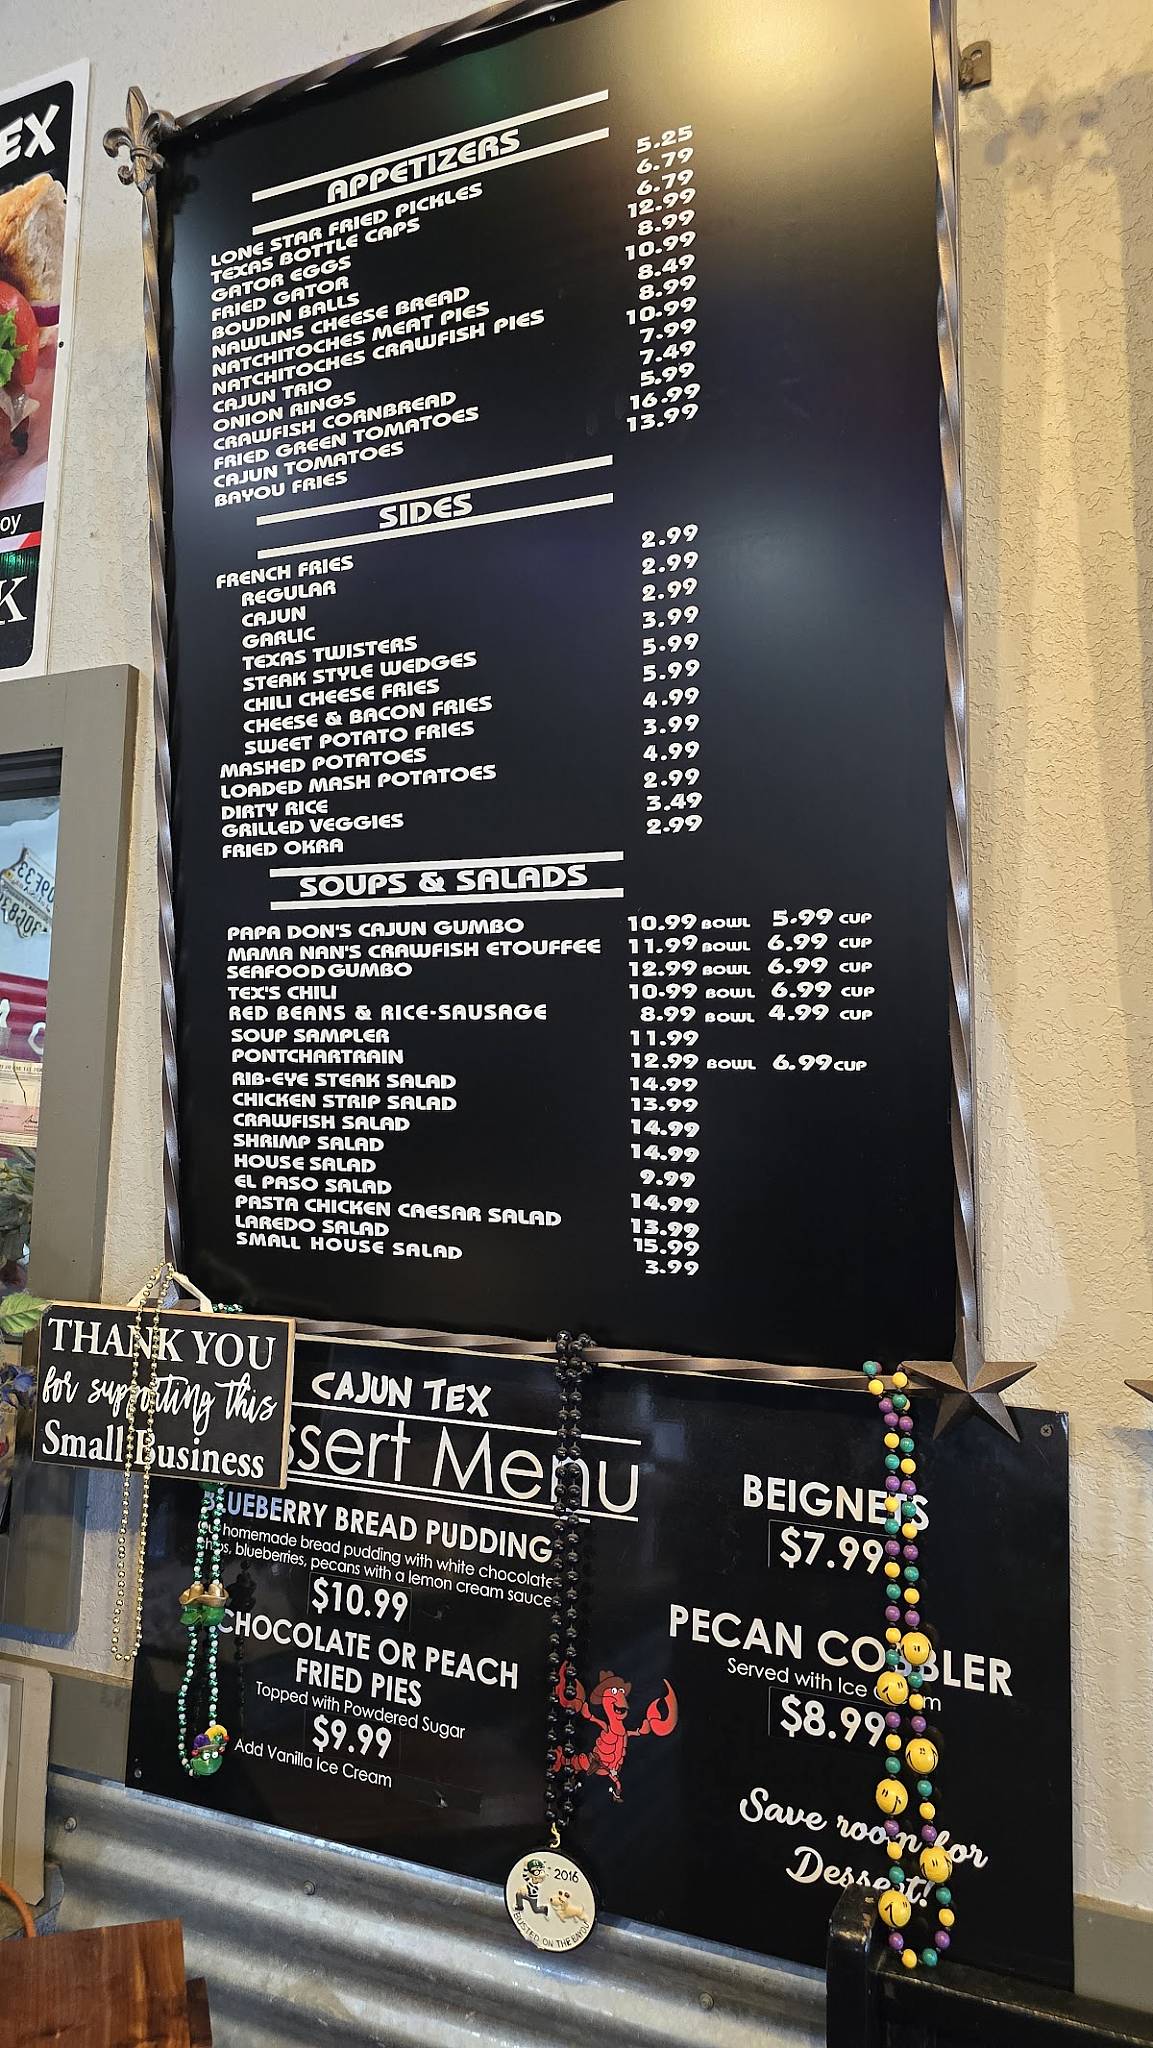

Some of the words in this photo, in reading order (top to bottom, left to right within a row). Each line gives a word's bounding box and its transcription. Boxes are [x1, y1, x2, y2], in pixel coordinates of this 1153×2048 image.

[637, 125, 693, 153] 5.25
[328, 129, 519, 203] APPETIZERS
[637, 169, 693, 195] 6.79
[212, 242, 263, 266] LONE
[270, 227, 322, 252] STAR
[329, 210, 388, 236] FRIED
[396, 183, 482, 218] PICKLES
[638, 210, 694, 235] 8.99
[211, 274, 284, 301] GATOR
[290, 256, 351, 281] EGGS
[638, 254, 694, 279] 8.49
[212, 309, 291, 339] BOUDIN
[299, 292, 359, 319] BALLS
[626, 297, 696, 324] 10.99
[213, 331, 365, 377] NATCHITOCHES
[372, 314, 433, 341] MEAT
[441, 301, 489, 325] PIES
[640, 341, 695, 365] 7.49
[213, 389, 275, 413] CAJUN
[282, 378, 331, 399] TRIO
[630, 384, 700, 409] 16.99
[214, 419, 315, 450] CRAWFISH
[323, 392, 456, 428] CORNBREAD
[214, 465, 277, 488] CAJUN
[284, 441, 403, 475] TOMATOES
[380, 493, 472, 529] SIDES
[642, 524, 698, 548] 2.99
[217, 565, 290, 588] FRENCH
[298, 555, 353, 577] FRIES
[642, 578, 697, 601] 2.99
[242, 606, 305, 627] CAJUN
[242, 650, 306, 670] TEXAS
[312, 636, 417, 662] TWISTERS
[643, 633, 698, 655] 5.99
[244, 695, 291, 712] CHILI
[299, 686, 374, 706] CHEESE
[382, 679, 439, 699] FRIES
[643, 687, 699, 708] 4.99
[245, 735, 312, 755] SWEET
[320, 728, 408, 748] POTATO
[415, 721, 474, 740] FRIES
[643, 741, 699, 761] 4.99
[221, 780, 302, 798] LOADED
[309, 775, 370, 793] MASH
[378, 765, 496, 787] POTATOES
[647, 792, 702, 811] 3.49
[222, 821, 304, 837] GRILLED
[309, 813, 403, 832] VEGGIES
[300, 873, 406, 897] SOUPS
[419, 872, 446, 892] &
[457, 864, 587, 891] SALADS
[228, 926, 280, 940] PAPA
[288, 924, 351, 939] DON'S
[359, 922, 426, 937] CAJUN
[434, 918, 524, 935] GUMBO
[628, 914, 696, 931] 10.99
[702, 918, 750, 929] BOWL
[773, 909, 833, 926] 5.99
[839, 913, 872, 924] CUP
[227, 964, 325, 978] SEAFOOD
[328, 962, 412, 977] GUMBO
[629, 960, 697, 976] 12.99
[703, 965, 751, 975] BOWL
[768, 957, 828, 974] 6.99
[839, 962, 872, 972] CUP
[229, 1006, 268, 1020] RED
[277, 1005, 345, 1020] BEANS
[355, 1005, 372, 1020] &
[381, 1004, 546, 1020] RICE-SAUSAGE
[640, 1006, 696, 1021] 8.99
[705, 1013, 755, 1022] BOWL
[768, 1004, 829, 1020] 4.99
[840, 1010, 872, 1020] CUP
[232, 1049, 403, 1064] PONTCHARTRAIN
[233, 1093, 316, 1107] CHICKEN
[323, 1095, 380, 1109] STRIP
[388, 1096, 456, 1110] SALAD
[631, 1098, 698, 1112] 13.99
[234, 1134, 310, 1148] SHRIMP
[318, 1136, 384, 1151] SALAD
[631, 1144, 699, 1162] 14.99
[235, 1175, 256, 1188] EL
[262, 1176, 318, 1191] PASO
[325, 1179, 392, 1194] SALAD
[631, 1193, 699, 1213] 14.99
[236, 1215, 315, 1232] LAREDO
[322, 1220, 389, 1236] SALAD
[634, 1238, 699, 1256] 15.99
[48, 1317, 184, 1362] THANK
[191, 1331, 276, 1370] YOU
[43, 1365, 79, 1404] for
[215, 1372, 277, 1423] this
[312, 1371, 412, 1408] CAJUN
[424, 1378, 491, 1417] TEX
[42, 1419, 123, 1463] Small
[135, 1429, 264, 1479] Business
[433, 1425, 639, 1513] Menu
[743, 1474, 930, 1531] BEIGNETS
[335, 1507, 417, 1540] BREAD
[427, 1520, 552, 1562] PUDDING
[780, 1525, 883, 1574] $7.99
[223, 1523, 297, 1553] homemade
[301, 1535, 340, 1553] bread
[344, 1545, 401, 1567] pudding
[405, 1553, 432, 1568] with
[437, 1559, 474, 1575] white
[479, 1565, 553, 1588] chocolate
[236, 1542, 306, 1567] blueberries,
[311, 1558, 360, 1574] pecans
[364, 1565, 391, 1580] with
[395, 1571, 404, 1582] a
[409, 1570, 452, 1590] lemon
[456, 1582, 503, 1599] cream
[508, 1590, 552, 1607] sauce
[312, 1577, 408, 1622] $10.99
[670, 1604, 801, 1659] PECAN
[218, 1609, 370, 1660] CHOCOLATE
[379, 1639, 416, 1669] OR
[426, 1647, 517, 1689] PEACH
[296, 1658, 362, 1698] FRIED
[372, 1673, 421, 1707] PIES
[728, 1658, 788, 1683] Served
[795, 1672, 832, 1691] with
[839, 1677, 867, 1697] Ice
[257, 1681, 308, 1705] Topped
[312, 1695, 339, 1712] with
[344, 1700, 418, 1729] Powdered
[422, 1717, 465, 1738] Sugar
[781, 1694, 885, 1746] $8.99
[313, 1715, 391, 1758] $9.99
[234, 1739, 263, 1756] Add
[268, 1745, 312, 1768] Vanilla
[317, 1757, 338, 1774] Ice
[343, 1763, 391, 1787] Cream
[740, 1787, 827, 1831] Save
[554, 1868, 580, 1883] 2016
[513, 1911, 539, 1942] BUSTED
[542, 1938, 553, 1948] ON
[556, 1938, 571, 1949] THE
[571, 1921, 590, 1943] BAYOU
